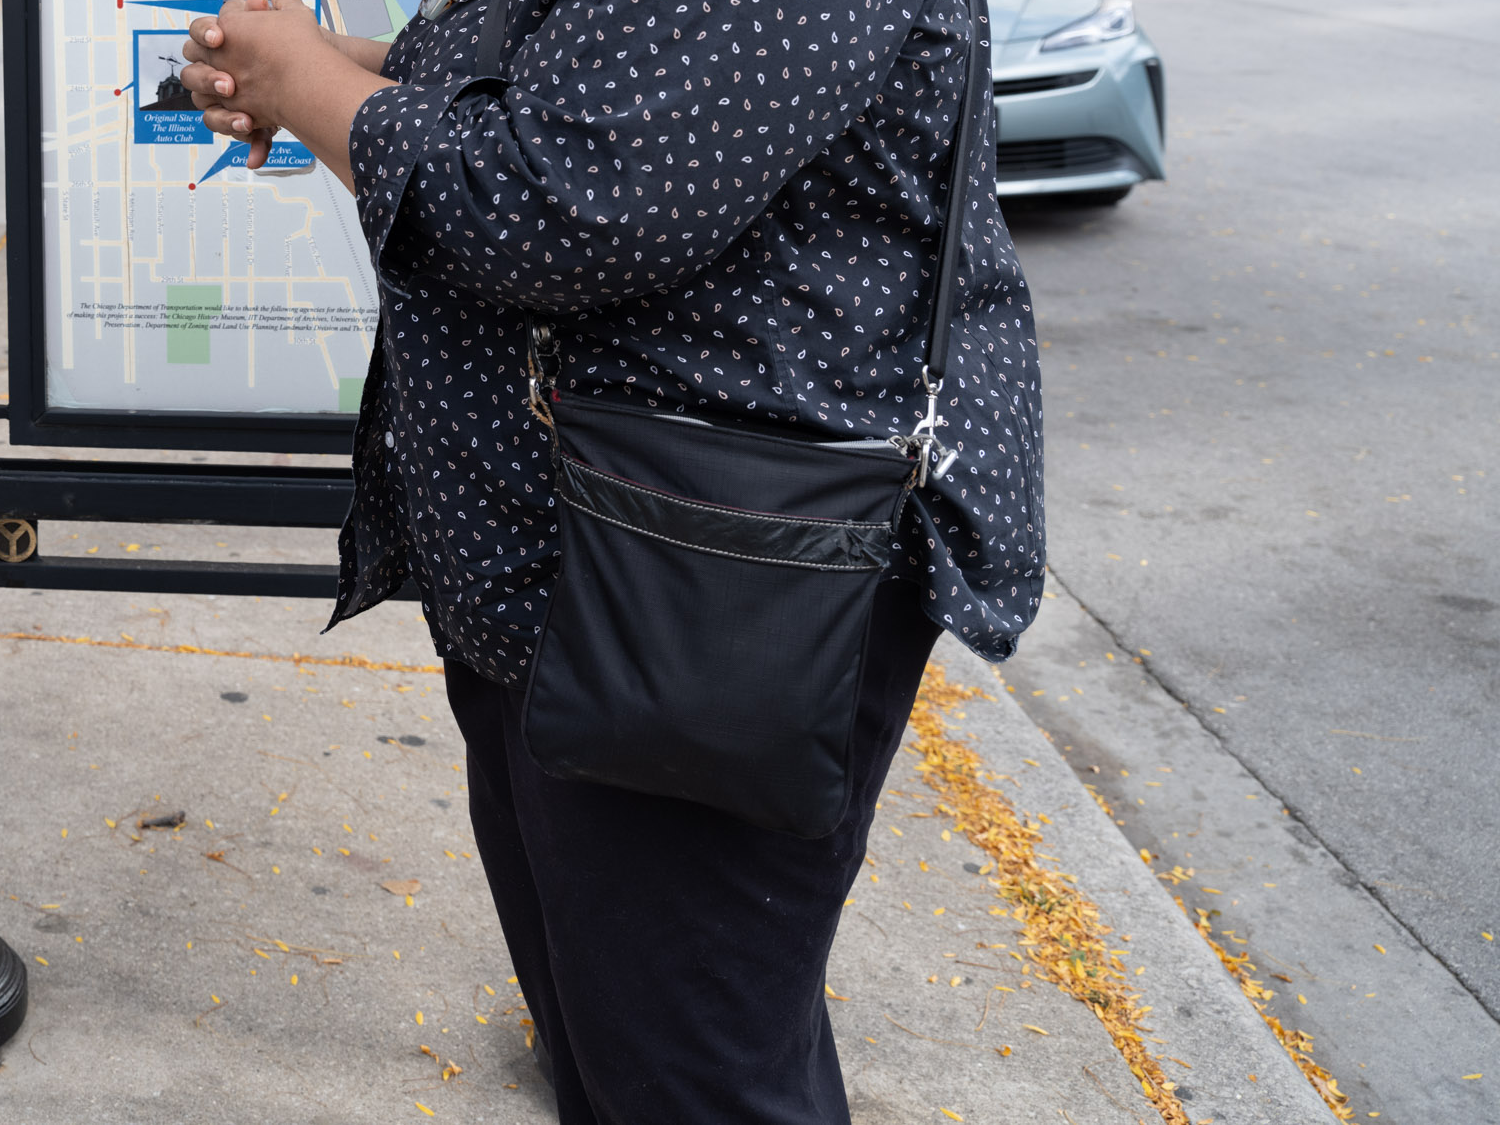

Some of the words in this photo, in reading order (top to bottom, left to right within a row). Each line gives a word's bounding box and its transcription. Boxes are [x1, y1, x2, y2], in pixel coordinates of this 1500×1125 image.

[144, 113, 177, 124] Original
[178, 113, 193, 122] Site
[194, 113, 205, 122] of
[151, 124, 166, 132] The
[168, 123, 195, 132] Illinois
[155, 133, 172, 142] Auto
[174, 133, 193, 142] Club
[267, 156, 288, 164] Gold
[289, 156, 311, 164] Coast
